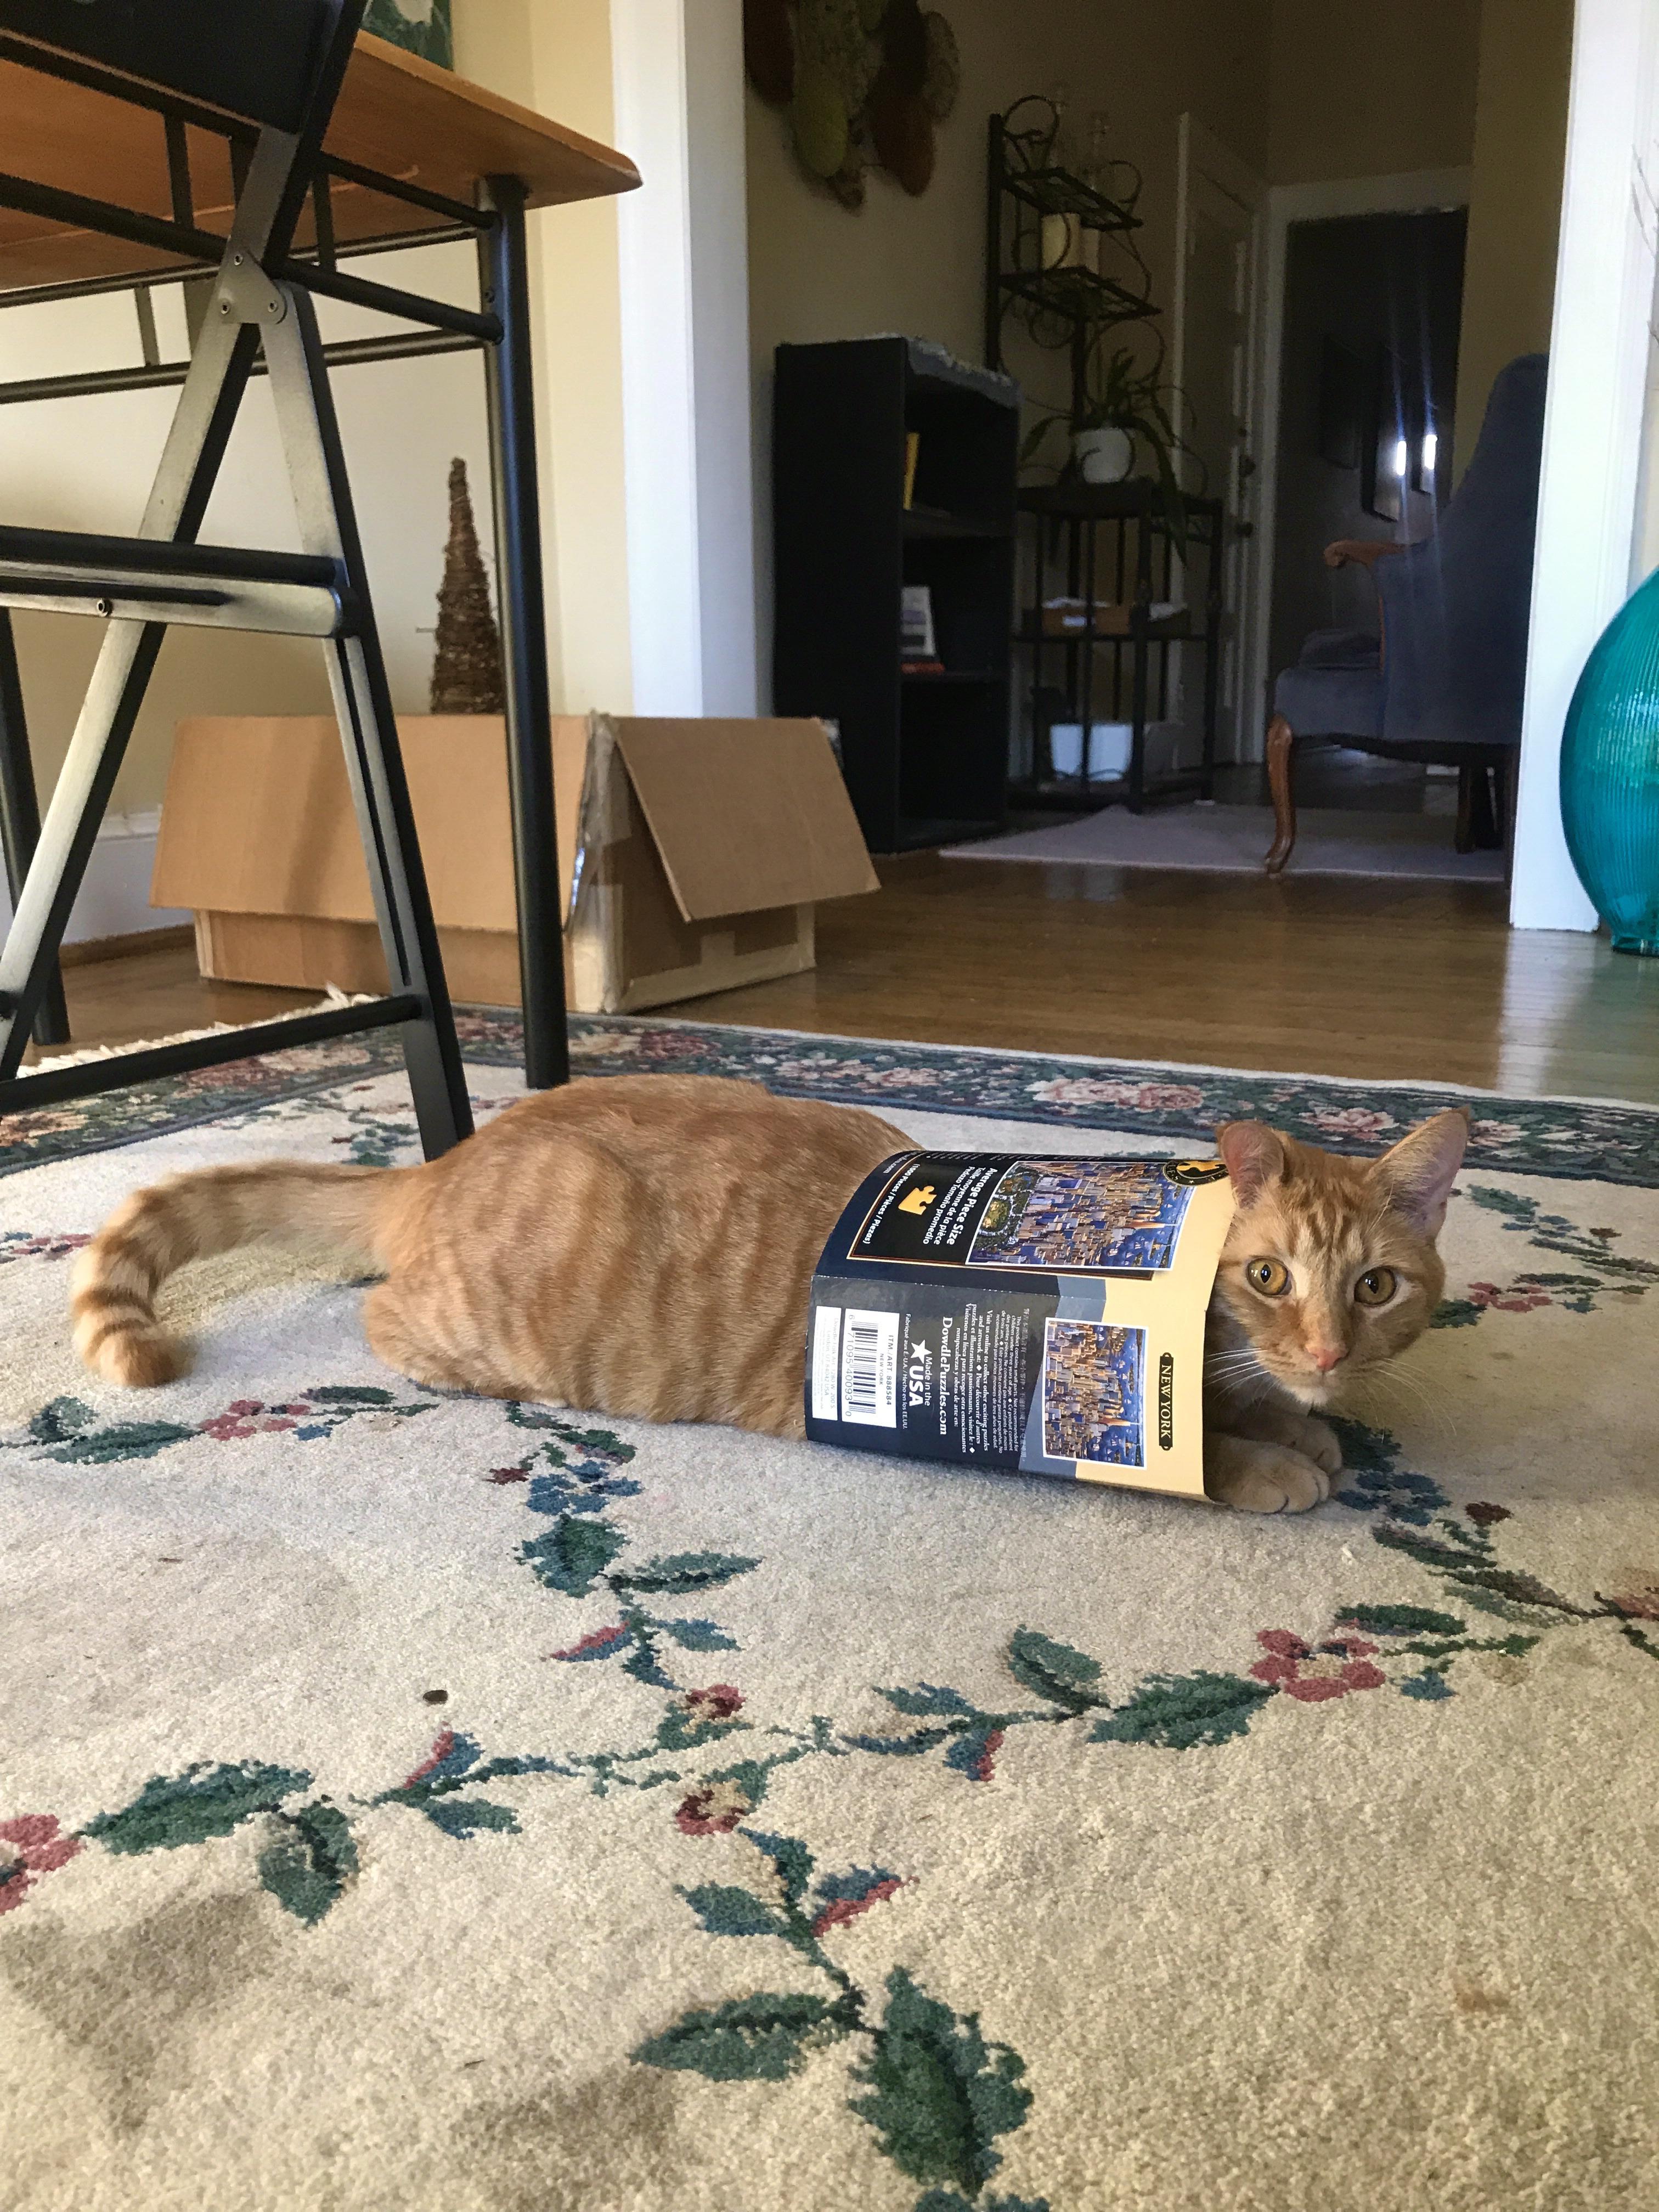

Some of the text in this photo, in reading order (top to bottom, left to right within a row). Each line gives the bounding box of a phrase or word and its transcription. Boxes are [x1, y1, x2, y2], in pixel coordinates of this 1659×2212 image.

[905, 1164, 921, 1176] (1000
[973, 1167, 986, 1179] Taille
[892, 1176, 909, 1192] Pieces
[952, 1180, 974, 1206] moyenne
[878, 1195, 895, 1215] Pièces
[923, 1166, 975, 1244] Pedazo Tamaño promedio
[946, 1168, 998, 1245] Average Piece Size
[948, 1207, 957, 1216] de
[863, 1219, 882, 1244] Piezas)
[934, 1225, 948, 1244] pièce
[846, 1332, 854, 1363] 71095
[909, 1365, 923, 1406] USA
[940, 1317, 952, 1435] DowdlePuzzles.com
[1161, 1365, 1171, 1438] NEW YORK
